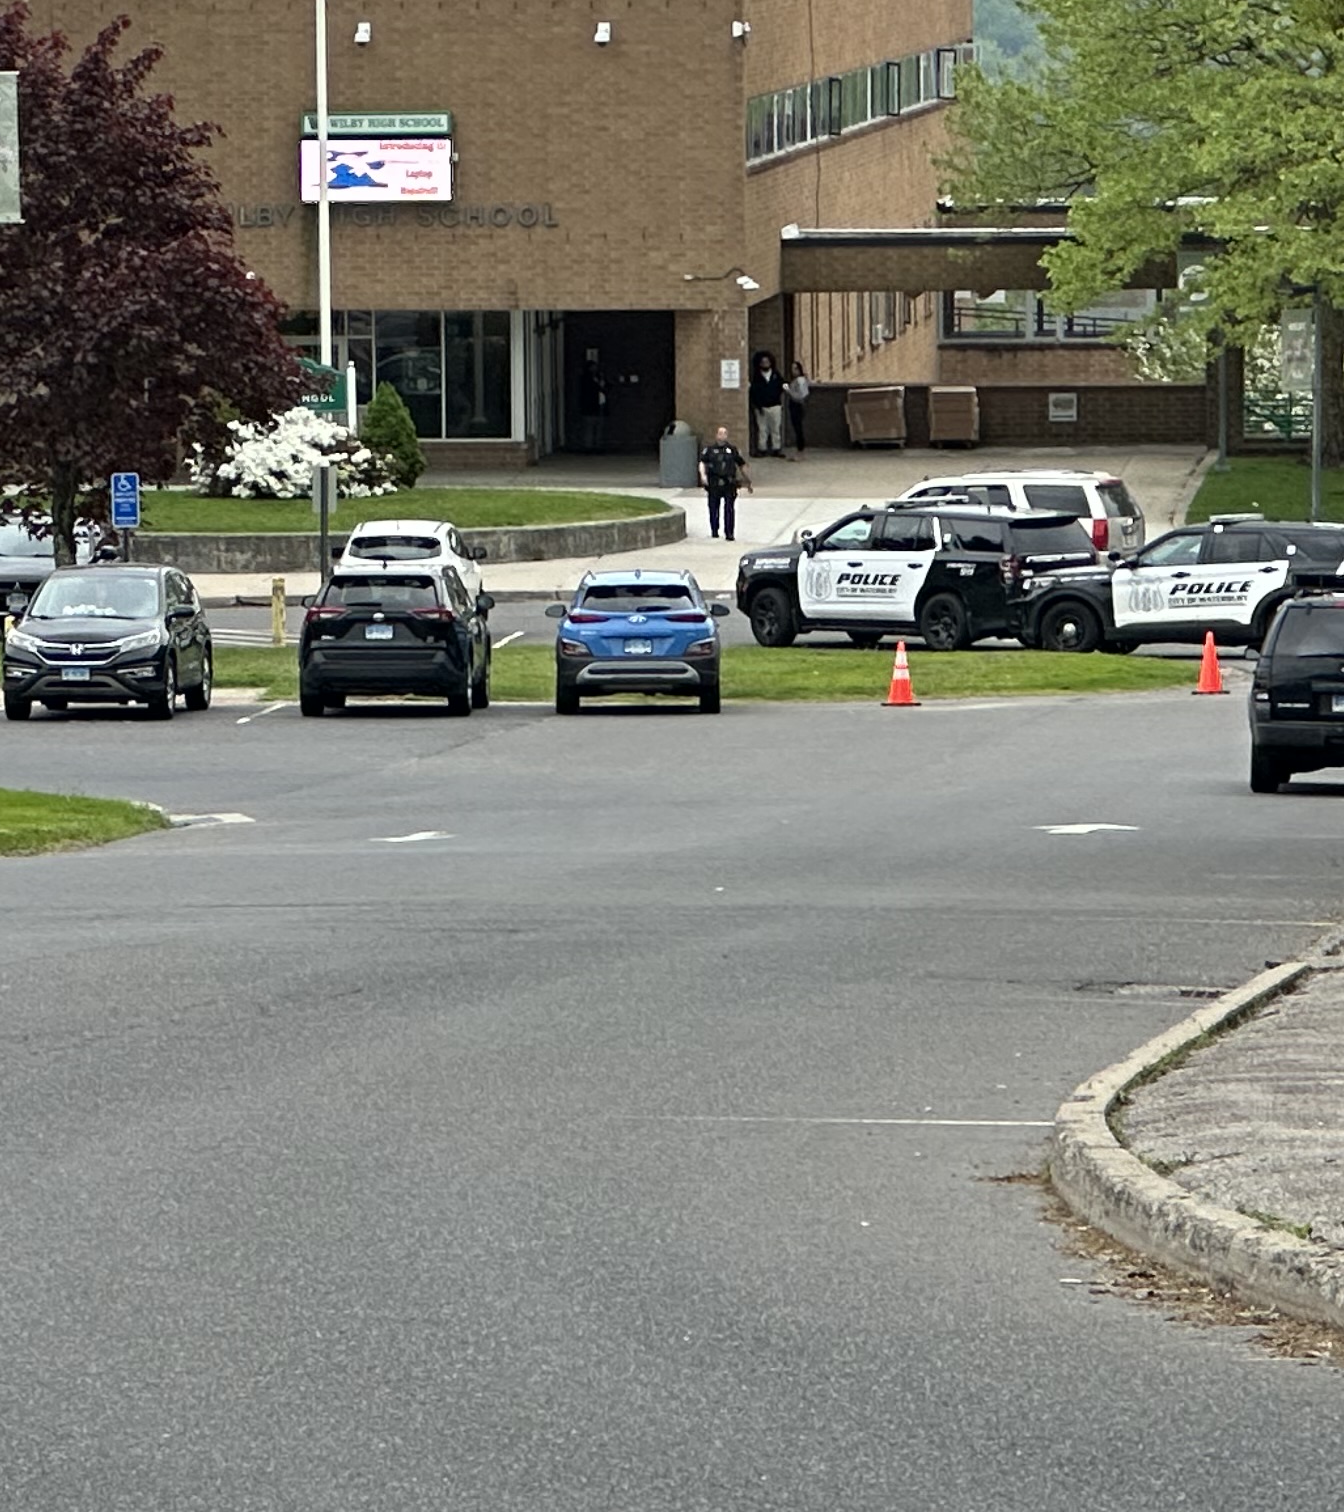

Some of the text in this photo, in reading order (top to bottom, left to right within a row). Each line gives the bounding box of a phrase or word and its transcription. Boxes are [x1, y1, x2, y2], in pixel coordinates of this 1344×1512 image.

[330, 118, 444, 128] WILBY HIGH SCHOOL
[416, 202, 559, 228] SCHOOL
[837, 573, 901, 586] POLICE
[1169, 580, 1254, 595] POLICE
